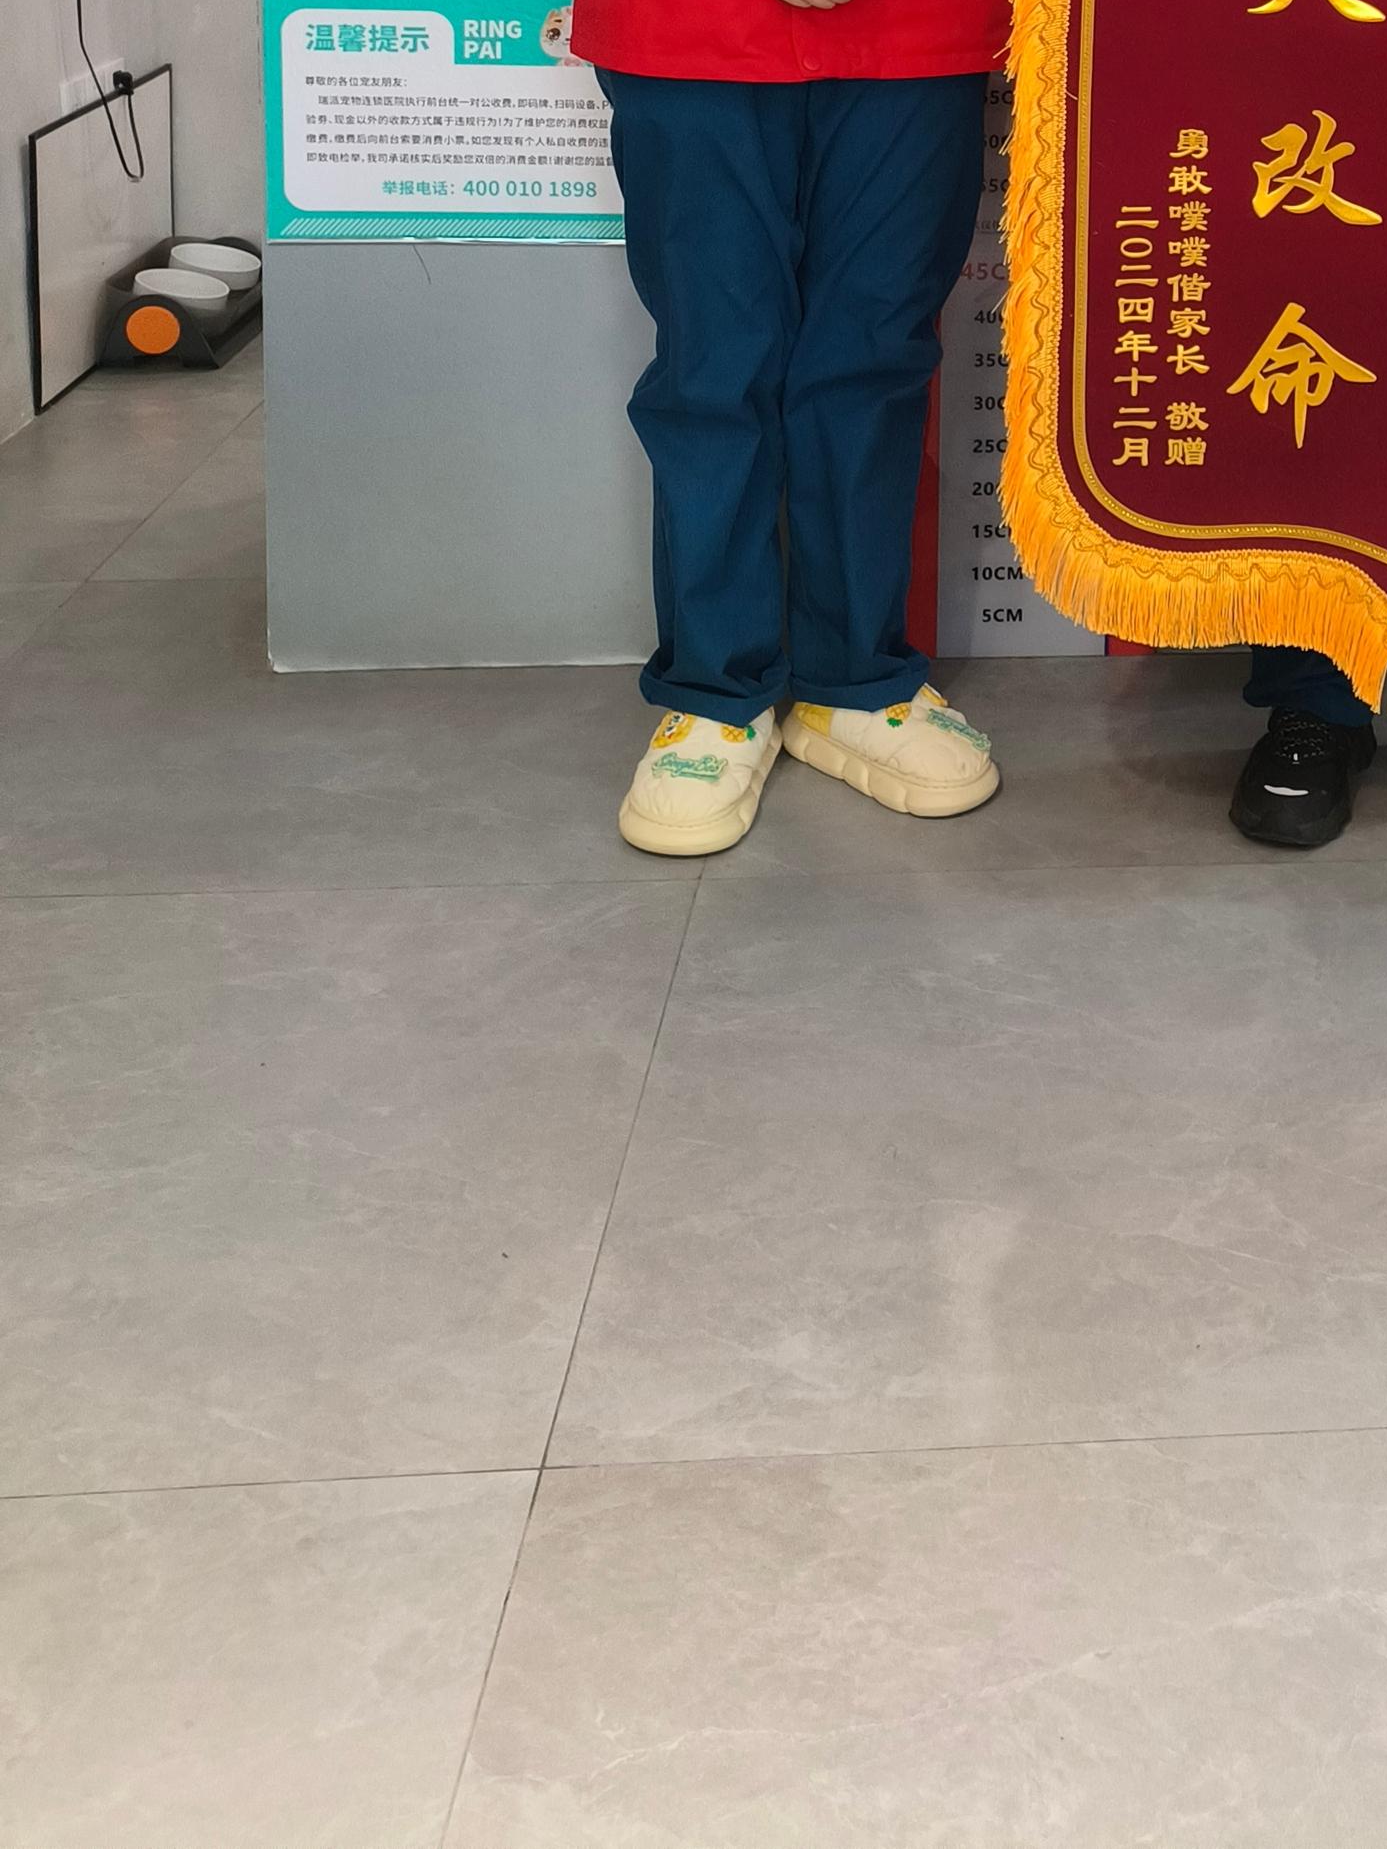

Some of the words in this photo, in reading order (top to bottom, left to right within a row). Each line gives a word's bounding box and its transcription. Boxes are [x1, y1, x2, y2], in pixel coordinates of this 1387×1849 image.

[464, 19, 522, 39] RING
[306, 24, 430, 53] 温馨提示
[464, 41, 502, 59] PAI
[463, 180, 500, 196] 400
[506, 180, 542, 197] 010
[549, 181, 598, 198] 1898
[961, 262, 1008, 281] 45C
[974, 309, 1004, 324] 40
[974, 353, 1008, 368] 35C
[973, 396, 1005, 411] 30C
[973, 439, 1008, 454] 25C
[972, 482, 999, 497] 20
[972, 524, 1013, 539] 15C
[971, 566, 1024, 581] 10CM
[982, 608, 1023, 623] 5CM
